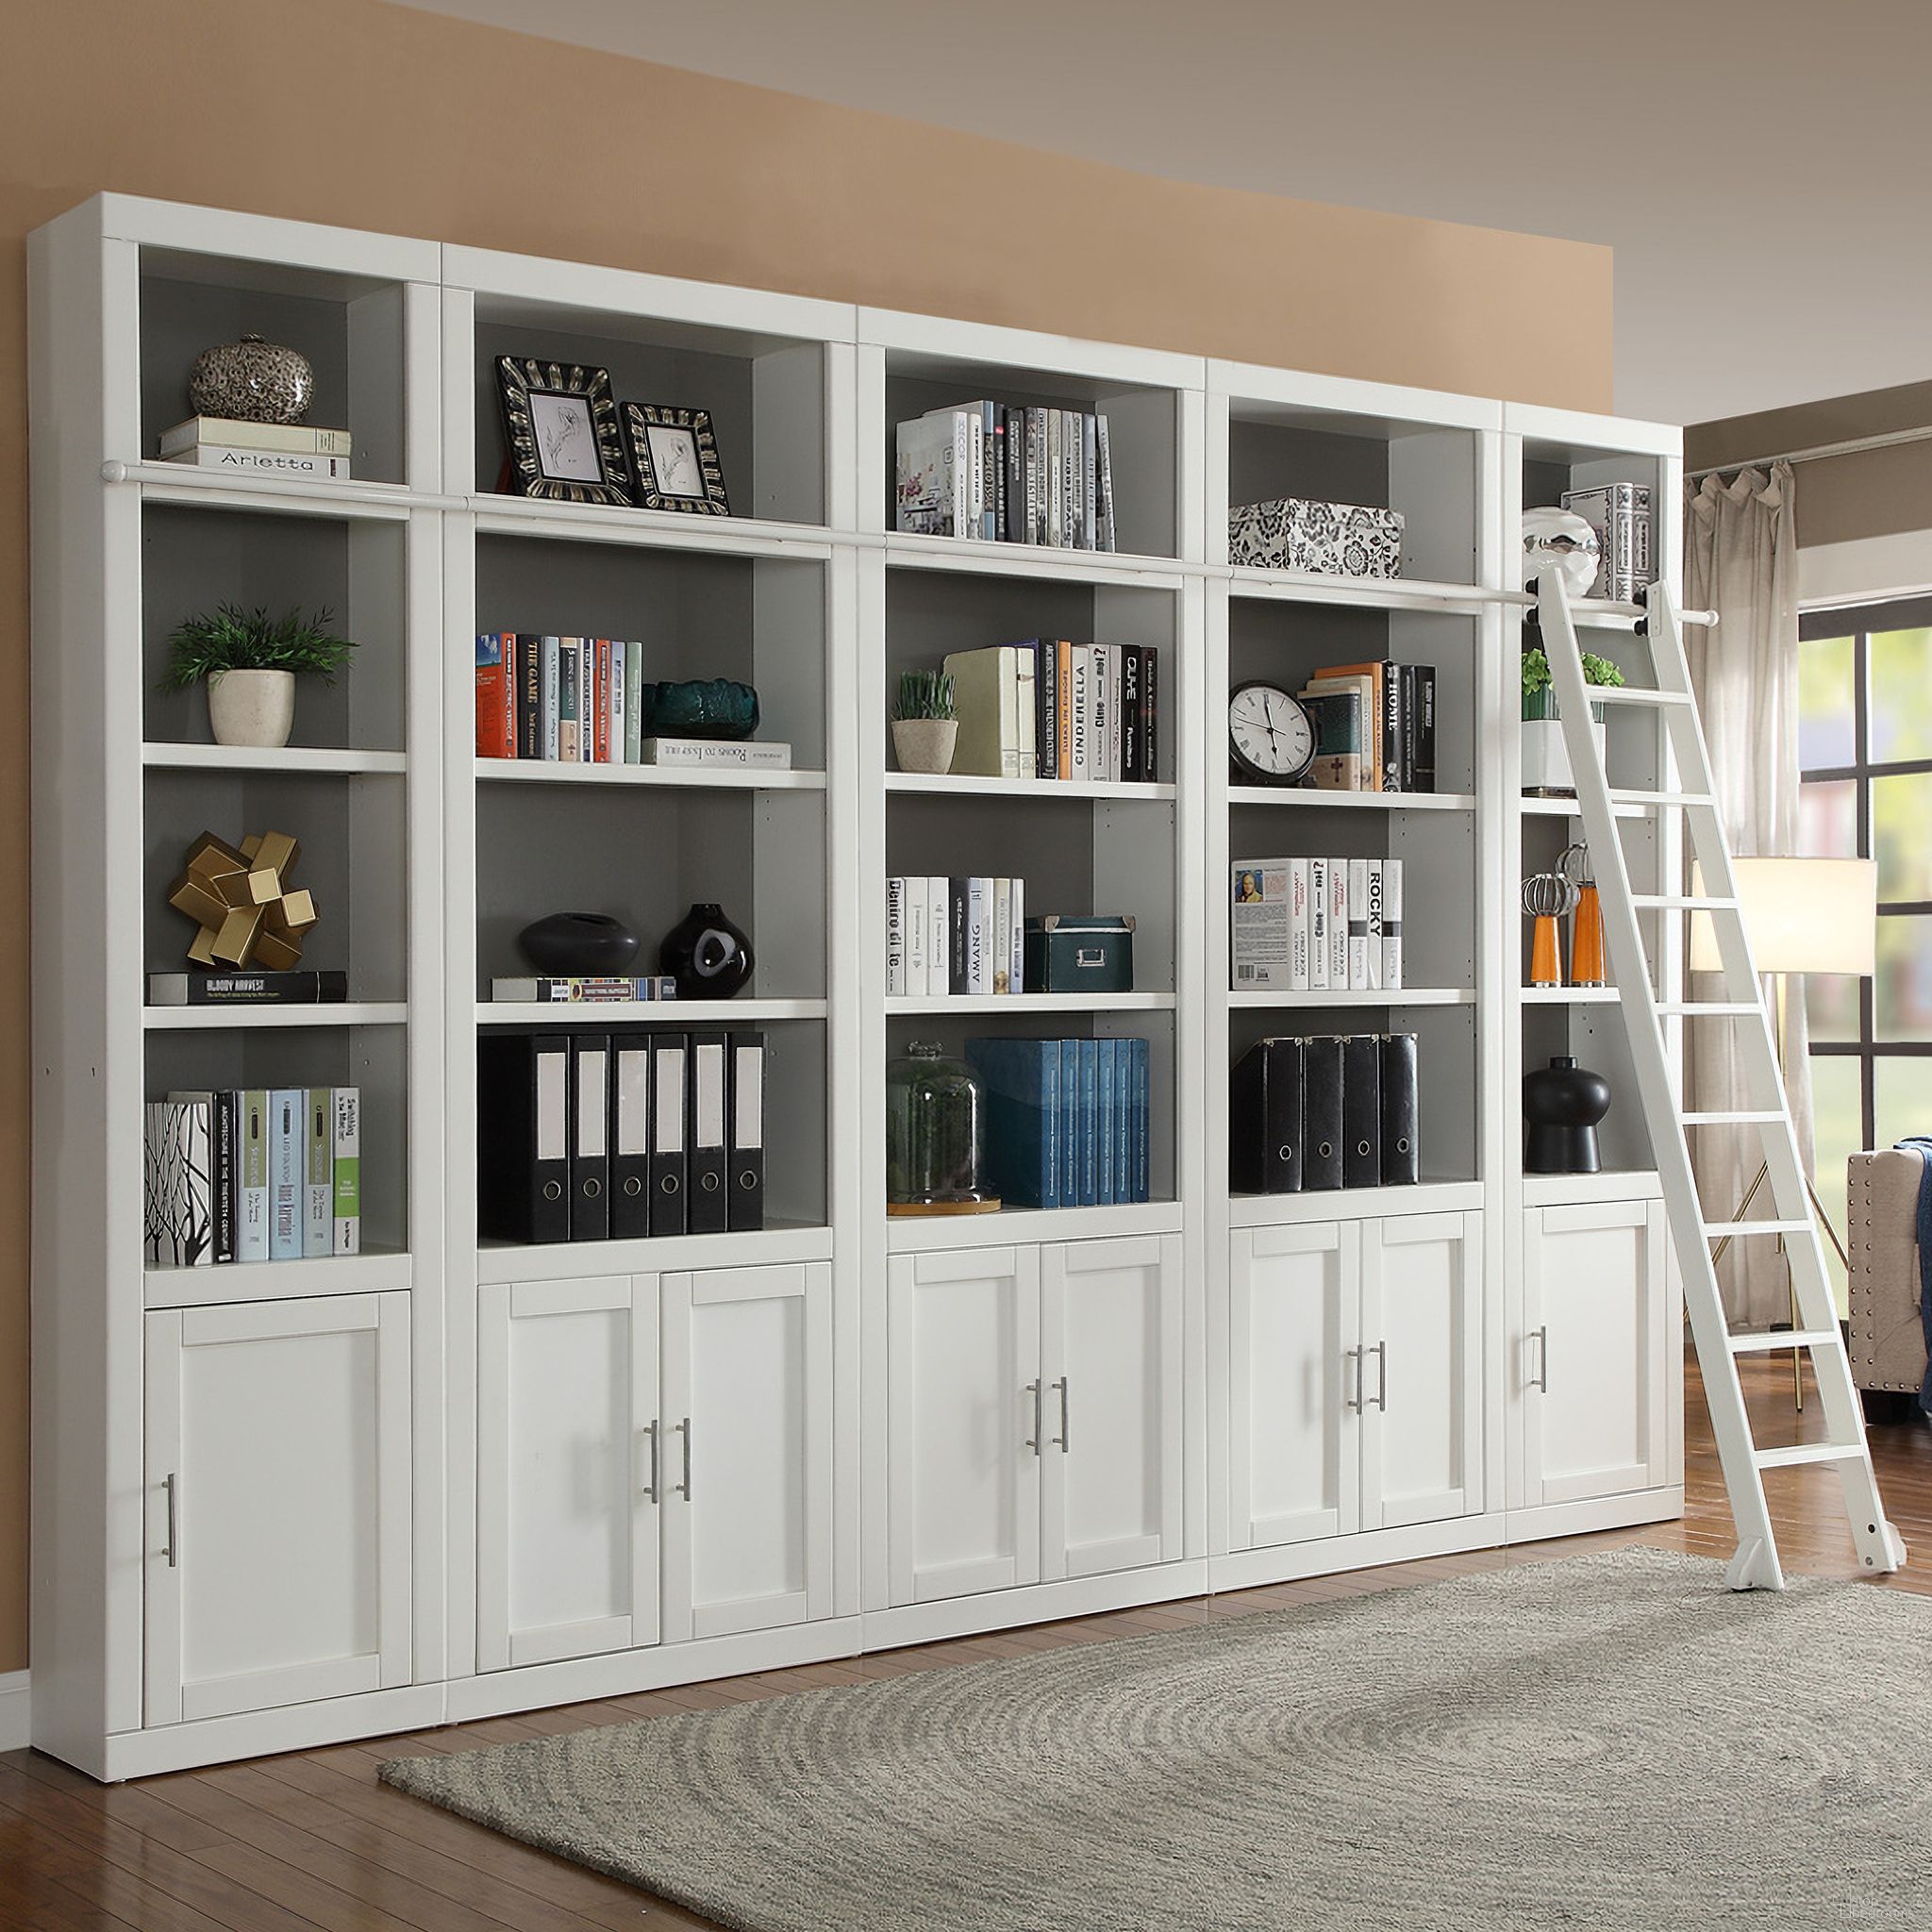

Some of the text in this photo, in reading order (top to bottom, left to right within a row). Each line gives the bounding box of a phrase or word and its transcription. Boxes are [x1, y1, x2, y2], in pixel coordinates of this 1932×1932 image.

[527, 641, 538, 704] THE GAME
[1075, 664, 1085, 765] CINDERELLA
[1388, 682, 1398, 731] HOME
[1370, 872, 1380, 937] ROCKY
